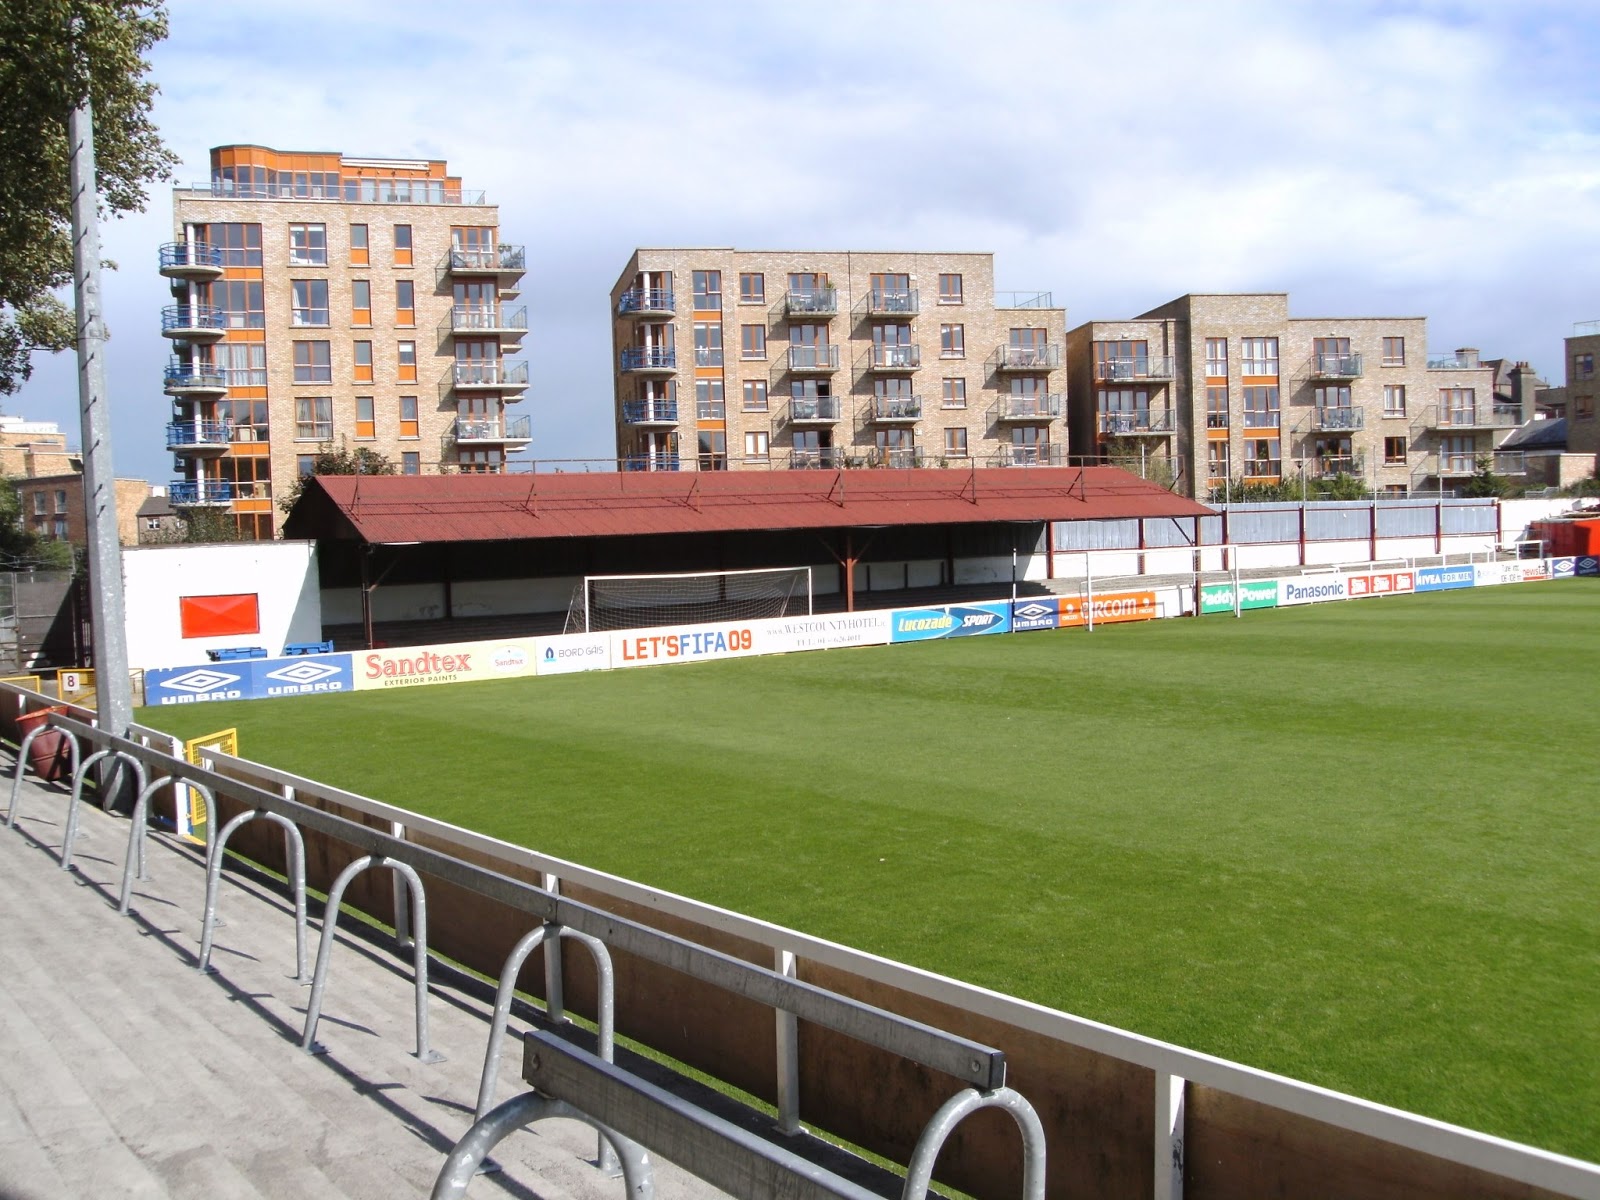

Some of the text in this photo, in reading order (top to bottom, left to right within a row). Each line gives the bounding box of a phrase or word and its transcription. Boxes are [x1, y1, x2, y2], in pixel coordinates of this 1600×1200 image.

[1416, 574, 1441, 586] NIVEA
[1442, 574, 1456, 582] FOR
[1458, 571, 1473, 581] MEN
[1239, 588, 1277, 602] Power
[1286, 580, 1344, 600] Panasonic
[898, 614, 995, 632] Lucozade SPORT
[1014, 617, 1053, 627] UMBRO
[558, 647, 584, 658] BORD
[365, 651, 473, 680] Sandtex
[67, 675, 75, 687] 8
[384, 674, 458, 687] EXTERIOR PAINTS
[268, 681, 342, 695] UMBRO
[161, 689, 241, 705] UMBRO
